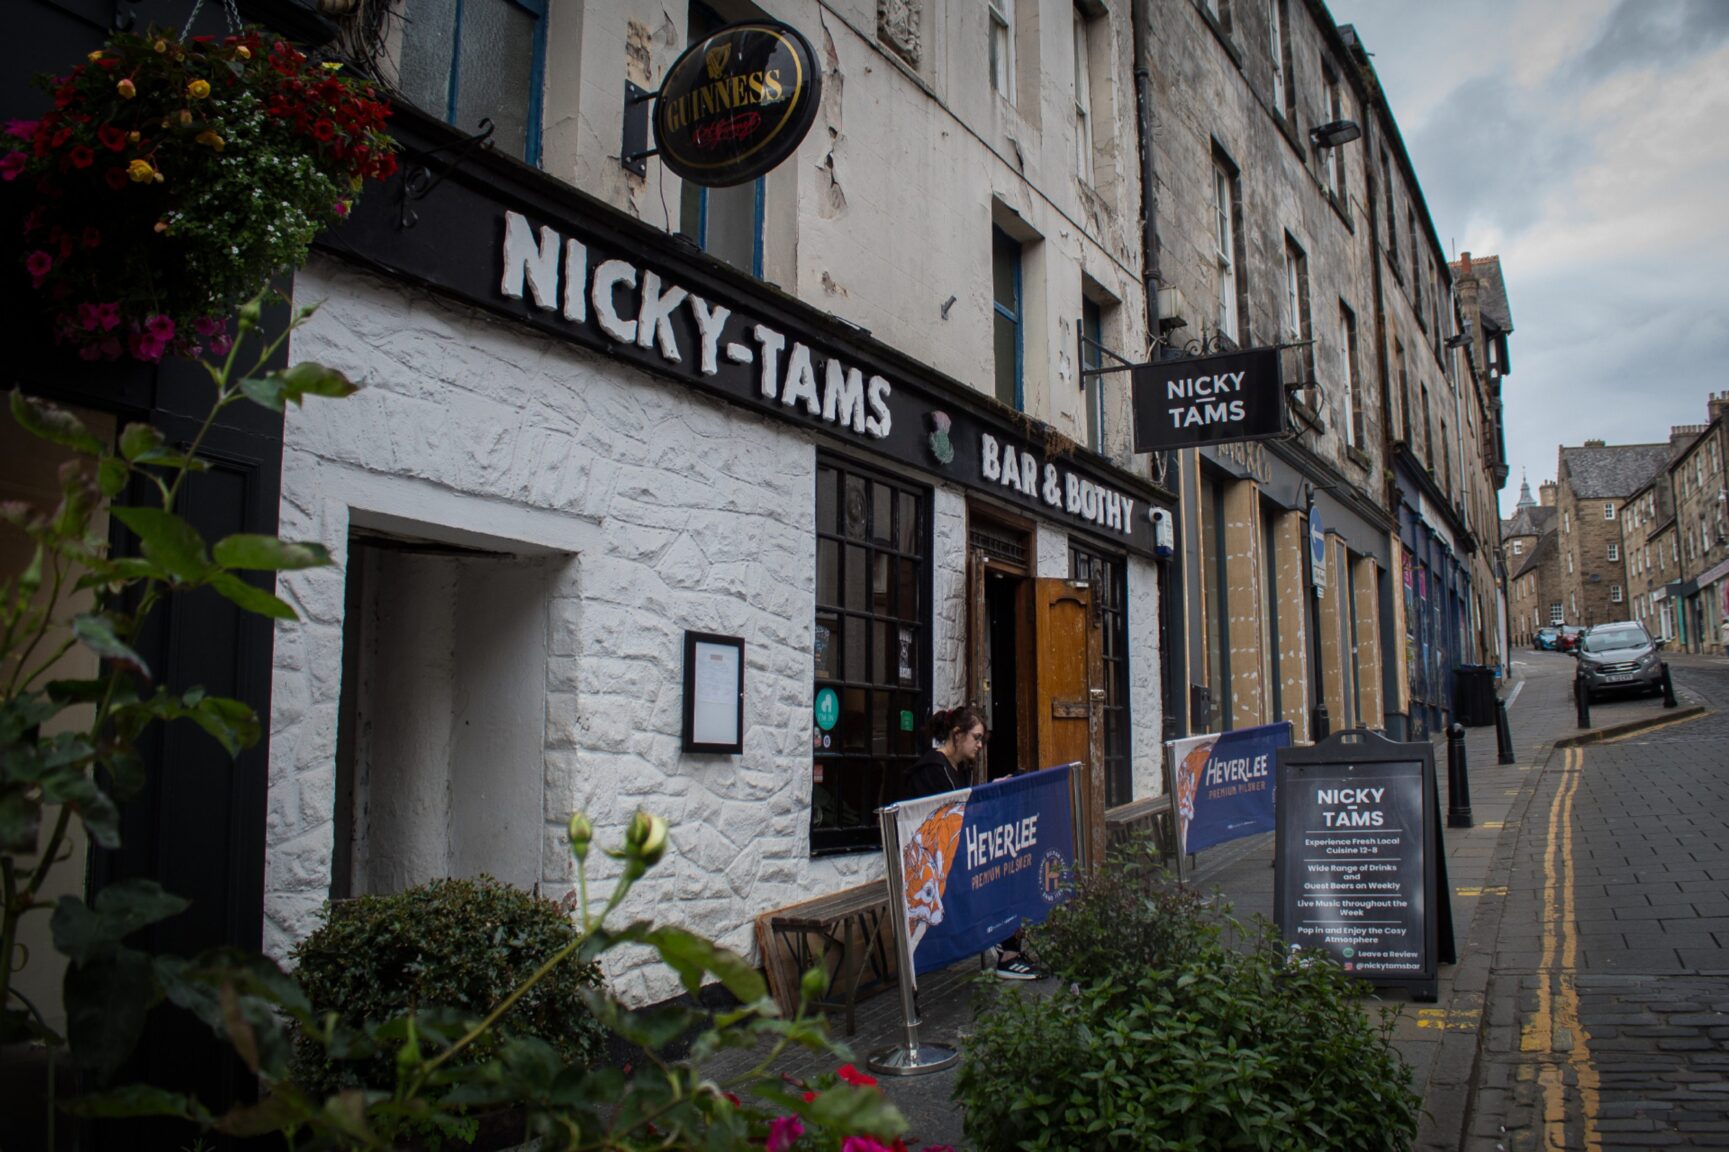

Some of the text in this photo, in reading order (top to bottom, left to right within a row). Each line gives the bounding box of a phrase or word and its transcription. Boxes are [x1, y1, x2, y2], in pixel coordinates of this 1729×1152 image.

[667, 69, 783, 133] GUINNESS
[1167, 371, 1246, 400] NICKY
[1168, 400, 1246, 429] TAMS
[982, 433, 1134, 535] BAR & BOTHY
[1206, 755, 1268, 786] HEVERLEE
[1317, 788, 1384, 804] NICKY
[1322, 811, 1384, 827] TAMS
[965, 815, 1037, 870] HEVERLEE
[1305, 838, 1351, 847] Experience
[1377, 837, 1400, 845] Local
[1359, 846, 1378, 854] 12-8
[1308, 864, 1330, 872] Wide
[1331, 864, 1358, 873] Range
[1368, 882, 1400, 890] Weekly
[1342, 900, 1391, 909] throughout
[1297, 926, 1314, 935] Pop
[1315, 926, 1324, 934] in
[1325, 926, 1342, 934] and
[1343, 926, 1367, 936] Enjoy
[1384, 928, 1407, 936] Cosy
[1325, 936, 1378, 944] Atmosphere
[1355, 961, 1420, 971] @nickytamsbar
